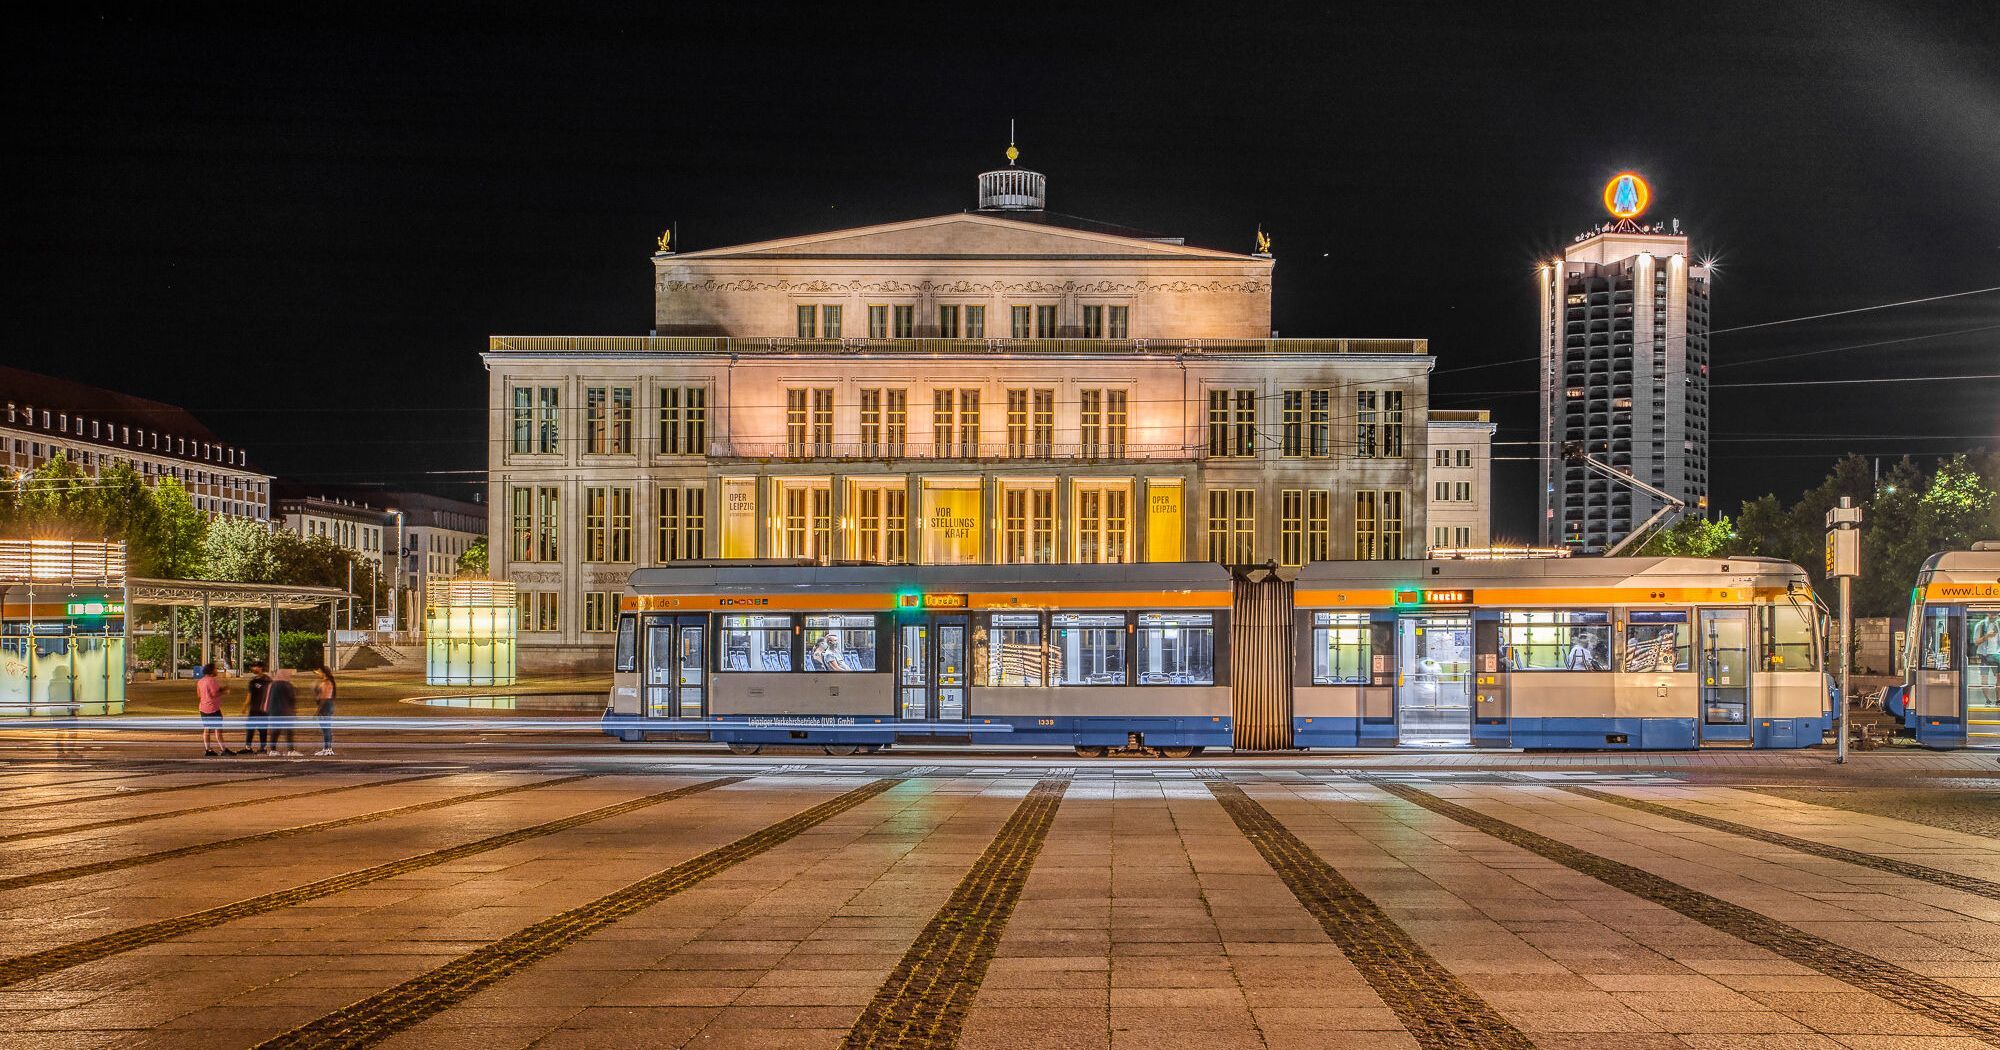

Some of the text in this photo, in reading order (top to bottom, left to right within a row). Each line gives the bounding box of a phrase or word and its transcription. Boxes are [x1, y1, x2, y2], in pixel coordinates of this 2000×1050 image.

[729, 493, 747, 502] OPER
[1152, 495, 1170, 504] OPER
[729, 502, 755, 511] LEIPZIG
[1152, 505, 1177, 514] LEIPZIG
[935, 507, 951, 517] VOR
[931, 518, 975, 528] STELLUNGS
[945, 528, 970, 538] KRAFT
[1941, 586, 1999, 596] www.L.de
[748, 716, 772, 728] Leipziger
[837, 716, 855, 727] GmbH
